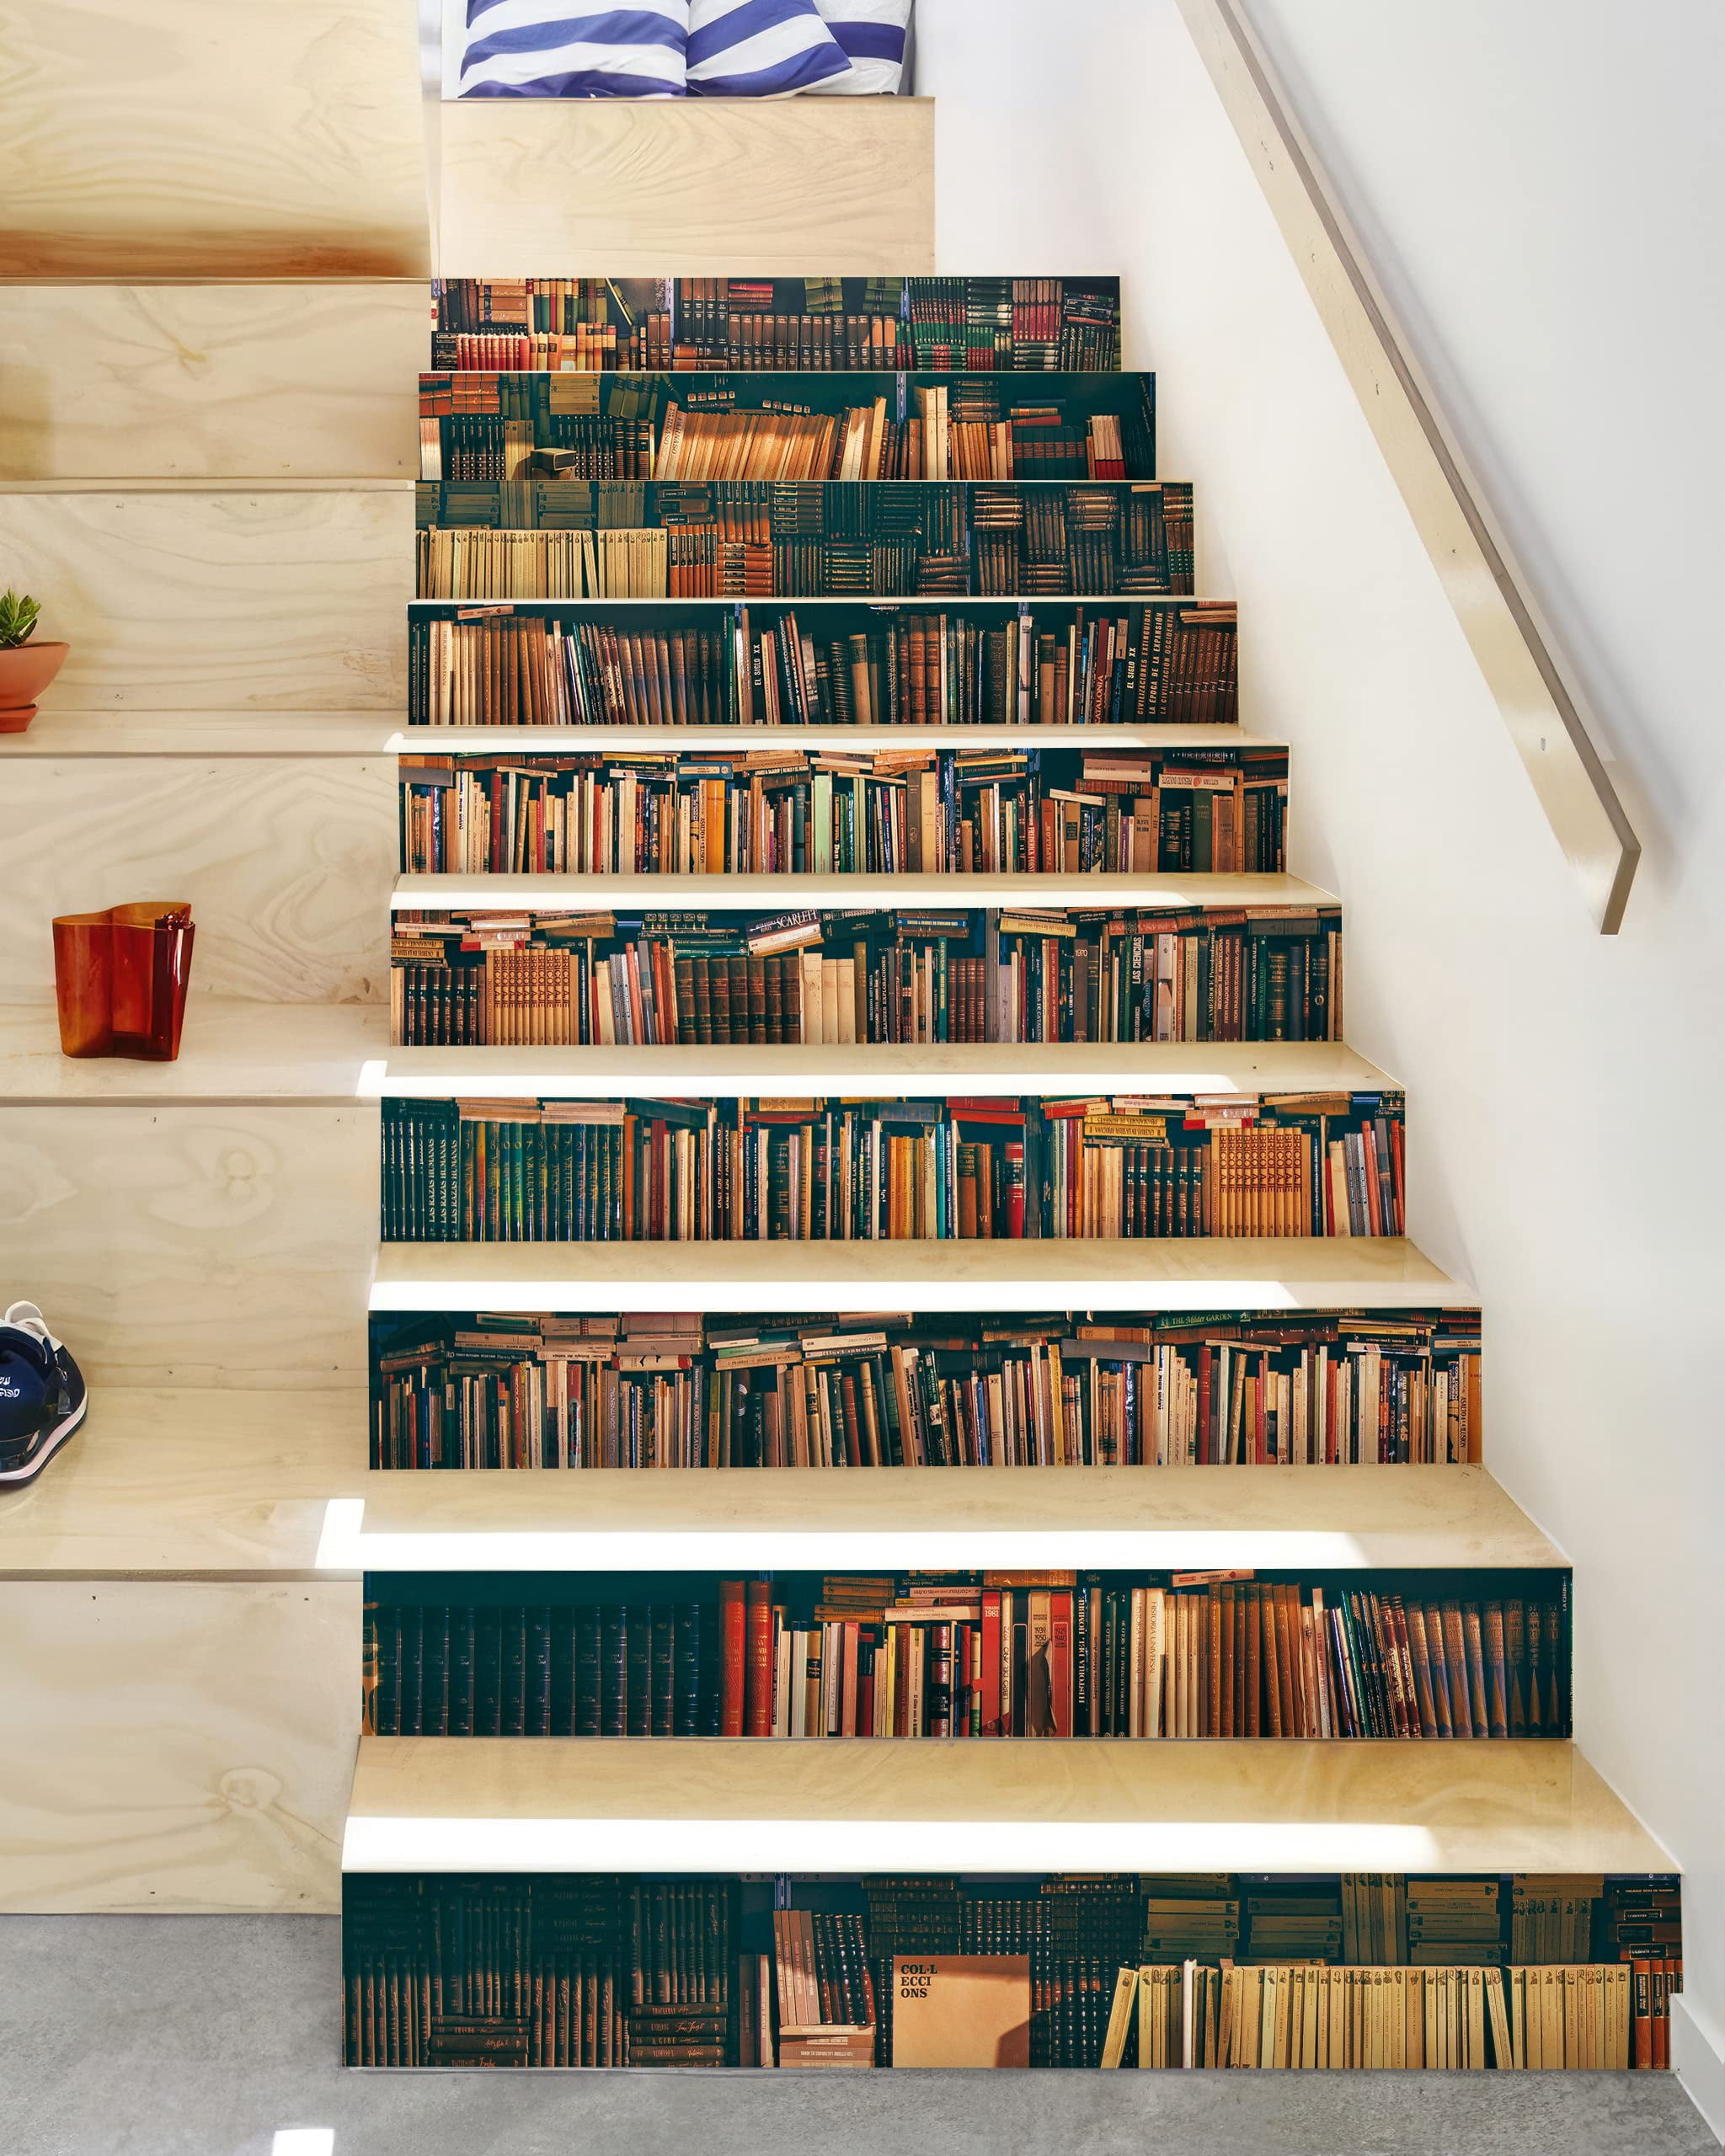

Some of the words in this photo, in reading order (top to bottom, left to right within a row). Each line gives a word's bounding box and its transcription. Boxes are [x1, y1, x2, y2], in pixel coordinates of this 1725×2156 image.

[662, 406, 676, 446] PARNASO
[671, 413, 685, 454] PARNASO
[1142, 608, 1152, 655] EXTINGUIDAS
[1153, 612, 1163, 652] EXPANSIÓN
[1165, 611, 1174, 654] OCCIDENTAL
[753, 643, 761, 654] XX
[1129, 647, 1136, 657] XX
[1137, 659, 1148, 714] CIVILIZACIONES
[1151, 668, 1158, 676] DE
[1161, 658, 1171, 703] CIVILIZACIÓN
[1095, 674, 1104, 723] CATALONIA
[776, 910, 818, 929] SCARLETT
[1133, 937, 1142, 969] CIENCIAS
[1132, 969, 1141, 984] LAS
[1206, 1313, 1232, 1322] GARDEN
[911, 1374, 919, 1411] personalidad
[1400, 1425, 1407, 1441] 45
[900, 1977, 932, 1986] ECCI
[900, 1988, 927, 1999] ONS
